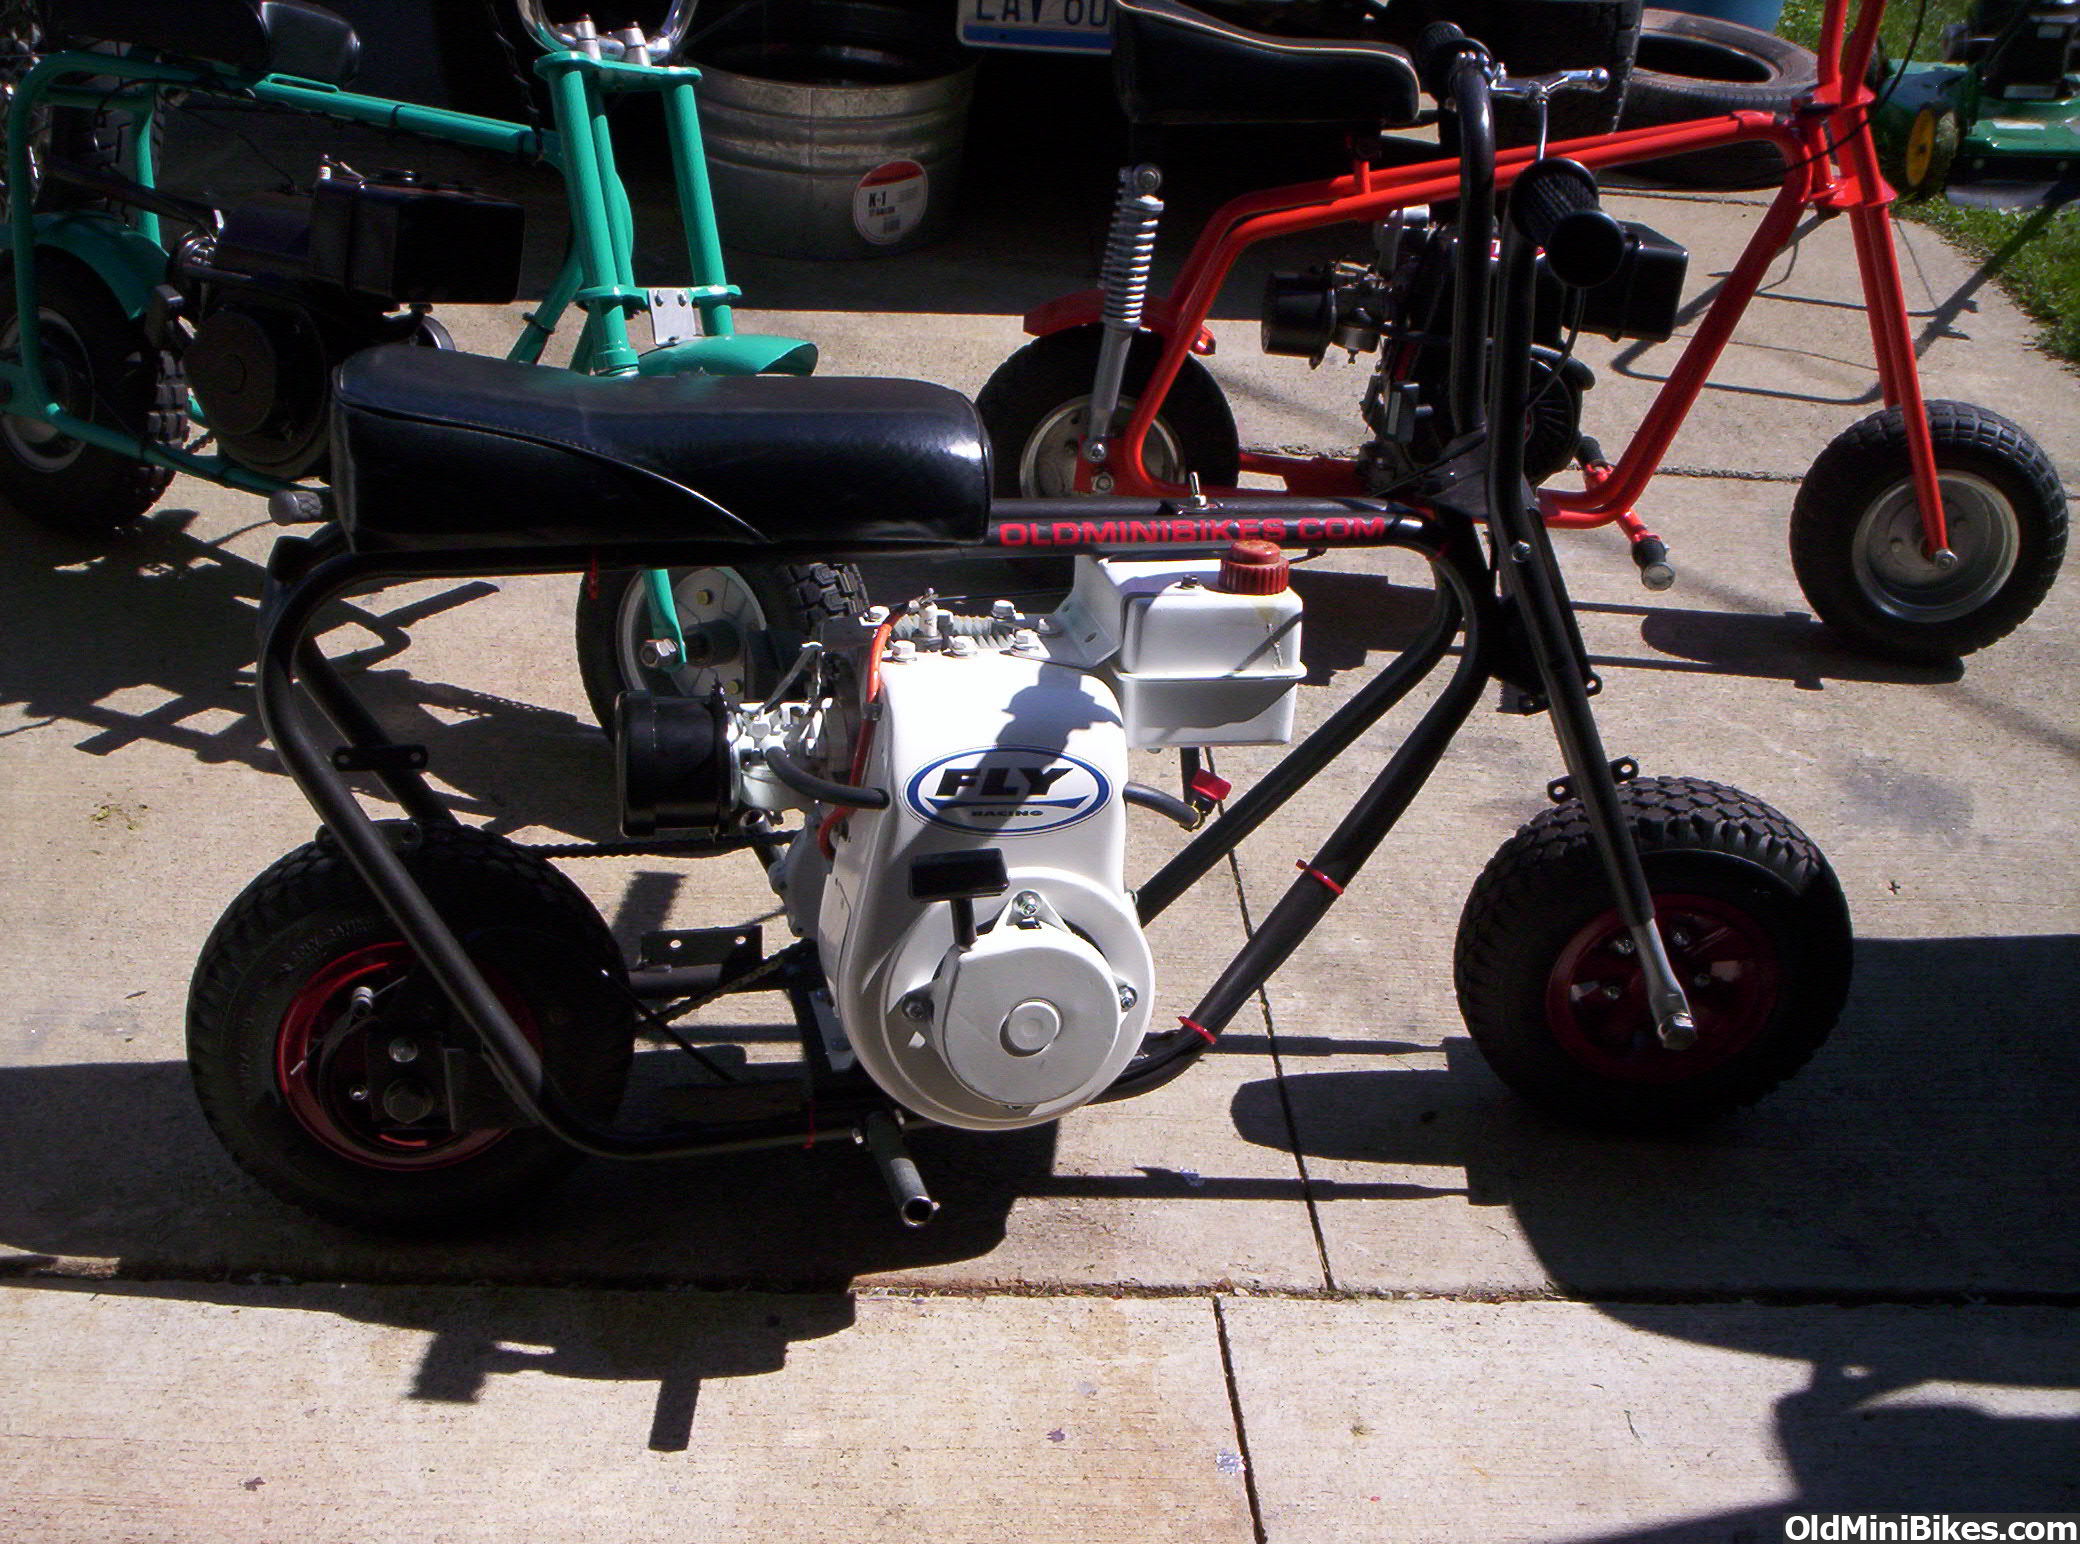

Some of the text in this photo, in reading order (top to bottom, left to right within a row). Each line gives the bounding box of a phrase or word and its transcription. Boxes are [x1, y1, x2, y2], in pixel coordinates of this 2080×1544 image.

[999, 516, 1385, 547] OLDMINIBIKESCOM
[935, 767, 1074, 797] FLY
[970, 809, 1045, 818] RACING
